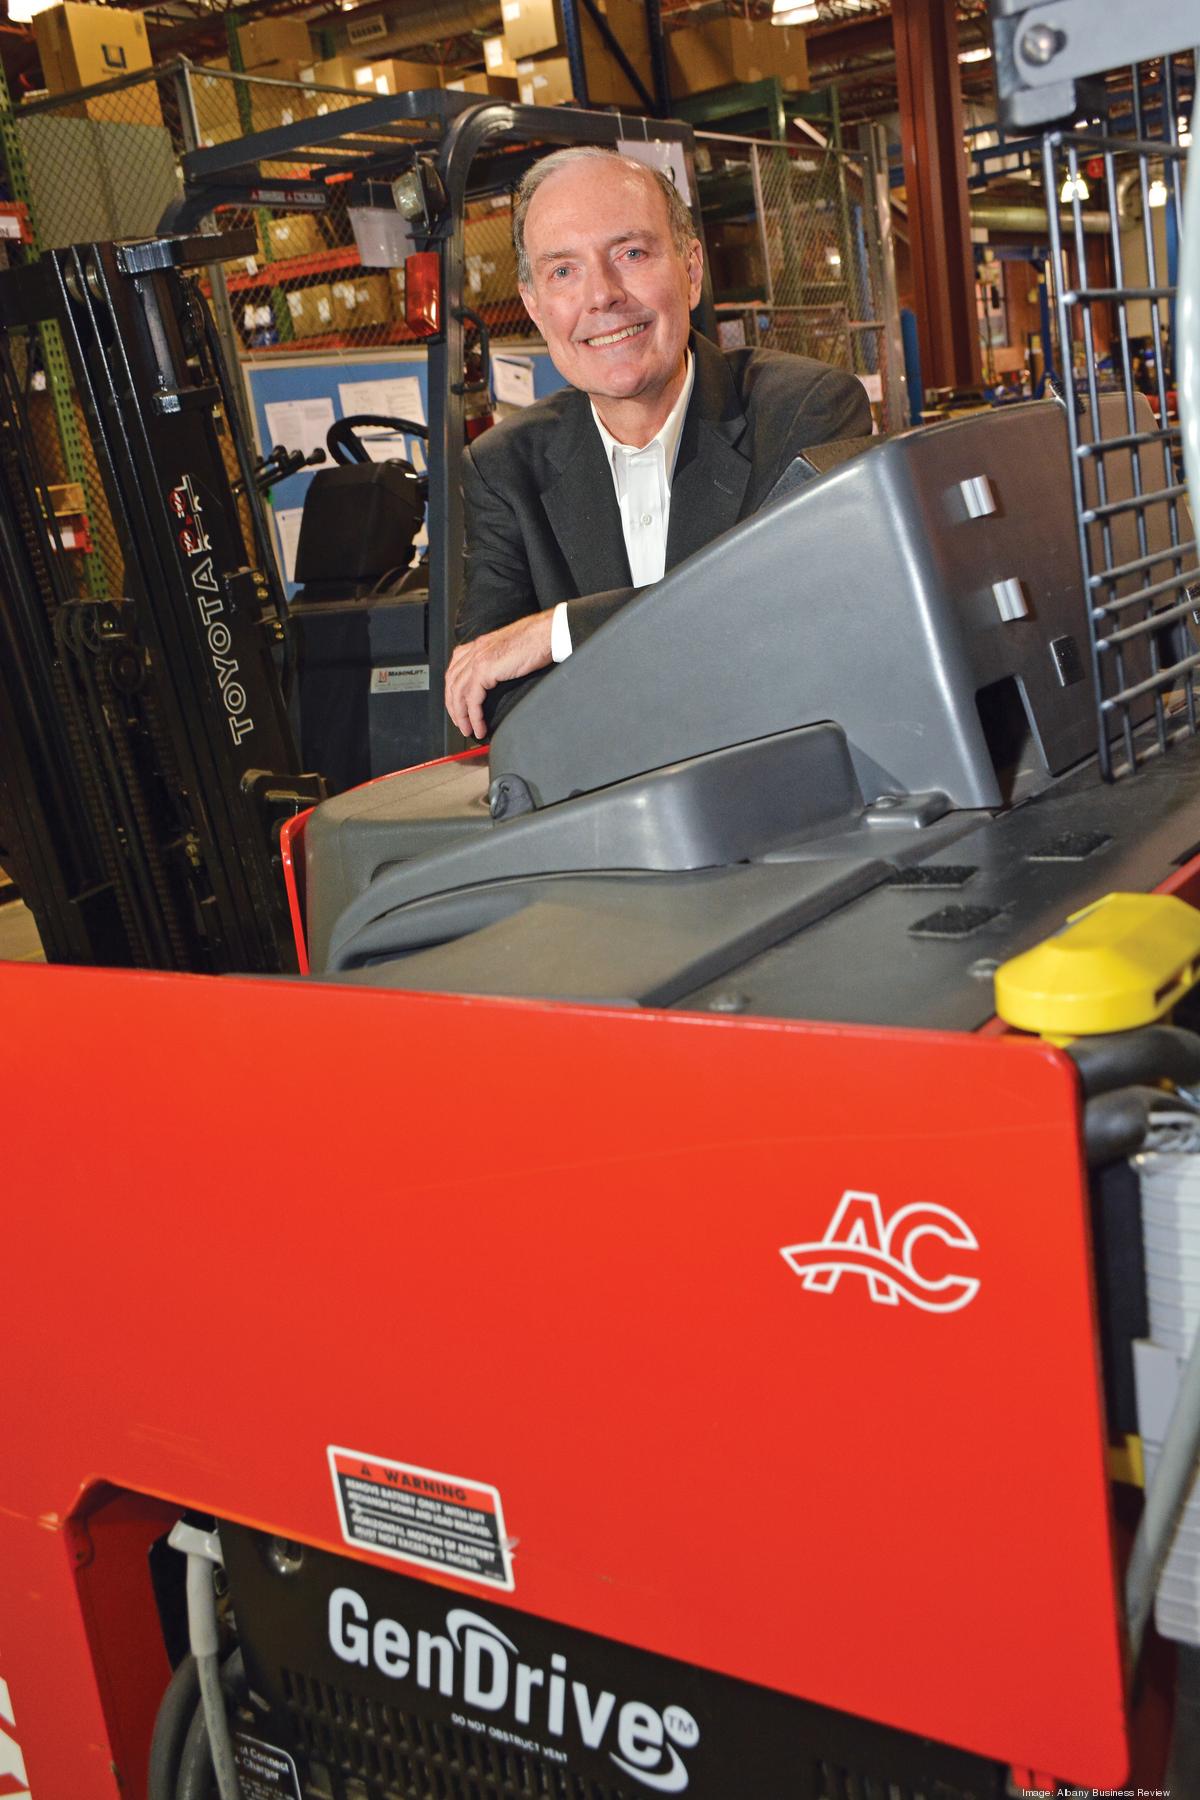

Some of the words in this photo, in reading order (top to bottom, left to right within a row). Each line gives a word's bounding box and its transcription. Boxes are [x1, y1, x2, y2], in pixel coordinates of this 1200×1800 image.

[192, 557, 254, 745] TOYOTA
[779, 1189, 980, 1313] AC
[384, 1469, 467, 1501] WARNING
[380, 1486, 417, 1506] BATTERY
[416, 1496, 442, 1513] ONLY
[442, 1502, 467, 1519] WITH
[467, 1509, 485, 1524] LIFT
[389, 1500, 415, 1518] DOWN
[414, 1507, 433, 1522] AND
[432, 1512, 453, 1528] LOAD
[377, 1531, 397, 1547] NOT
[405, 1527, 443, 1548] MOTION
[456, 1541, 495, 1562] BATTERY
[328, 1587, 664, 1768] GenDrive
[451, 1712, 466, 1726] DO
[467, 1718, 486, 1732] NOT
[488, 1726, 540, 1752] OBSTRUCT
[543, 1746, 568, 1763] VENT
[250, 1748, 289, 1773] Connect
